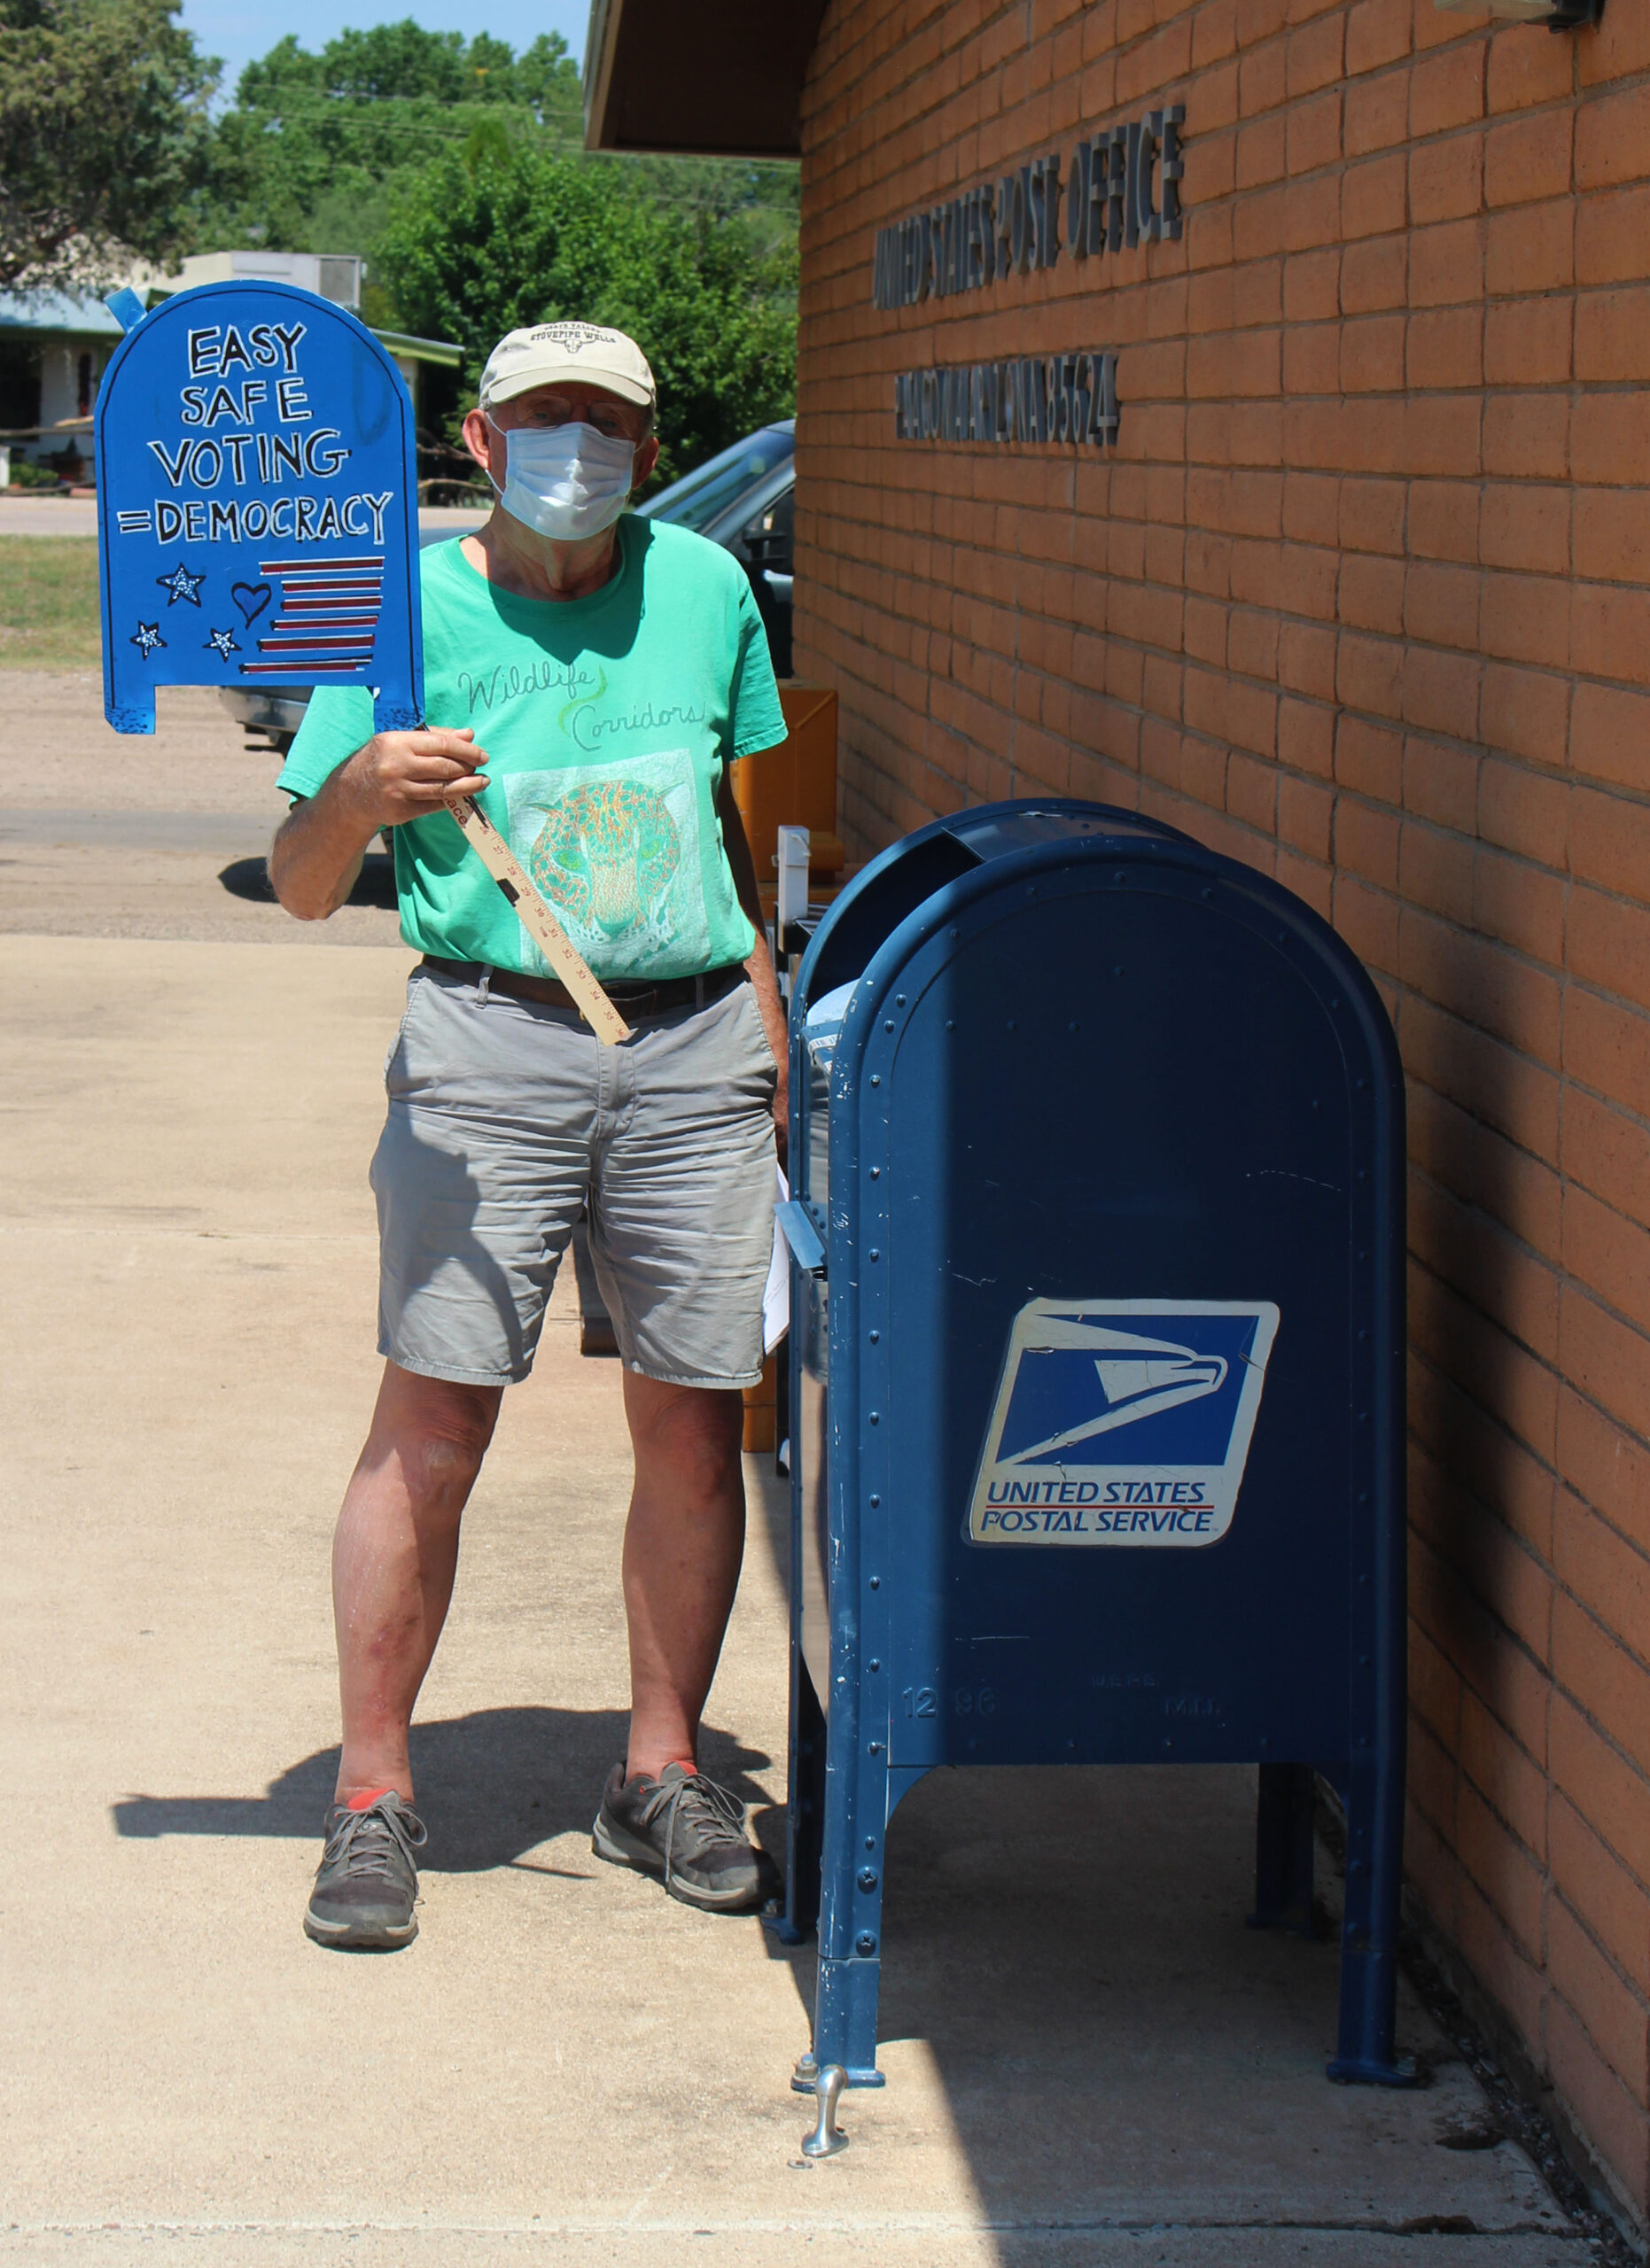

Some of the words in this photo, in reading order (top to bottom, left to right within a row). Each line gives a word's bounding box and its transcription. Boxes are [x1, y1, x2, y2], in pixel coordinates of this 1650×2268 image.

[993, 153, 1061, 282] POST
[1066, 105, 1186, 260] OFFICE
[187, 322, 307, 379] EASY
[530, 330, 580, 341] STOVEPIPE
[584, 330, 617, 344] WELLS
[180, 377, 313, 428] SAFE
[148, 428, 352, 488] VOTING
[457, 661, 595, 714] Wildlife
[572, 701, 706, 753] Corridors
[987, 1481, 1099, 1503] UNITED
[1103, 1481, 1205, 1503] STATES
[981, 1511, 1088, 1532] POSTAL
[1095, 1511, 1214, 1532] SERVICE
[901, 1687, 938, 1719] 12
